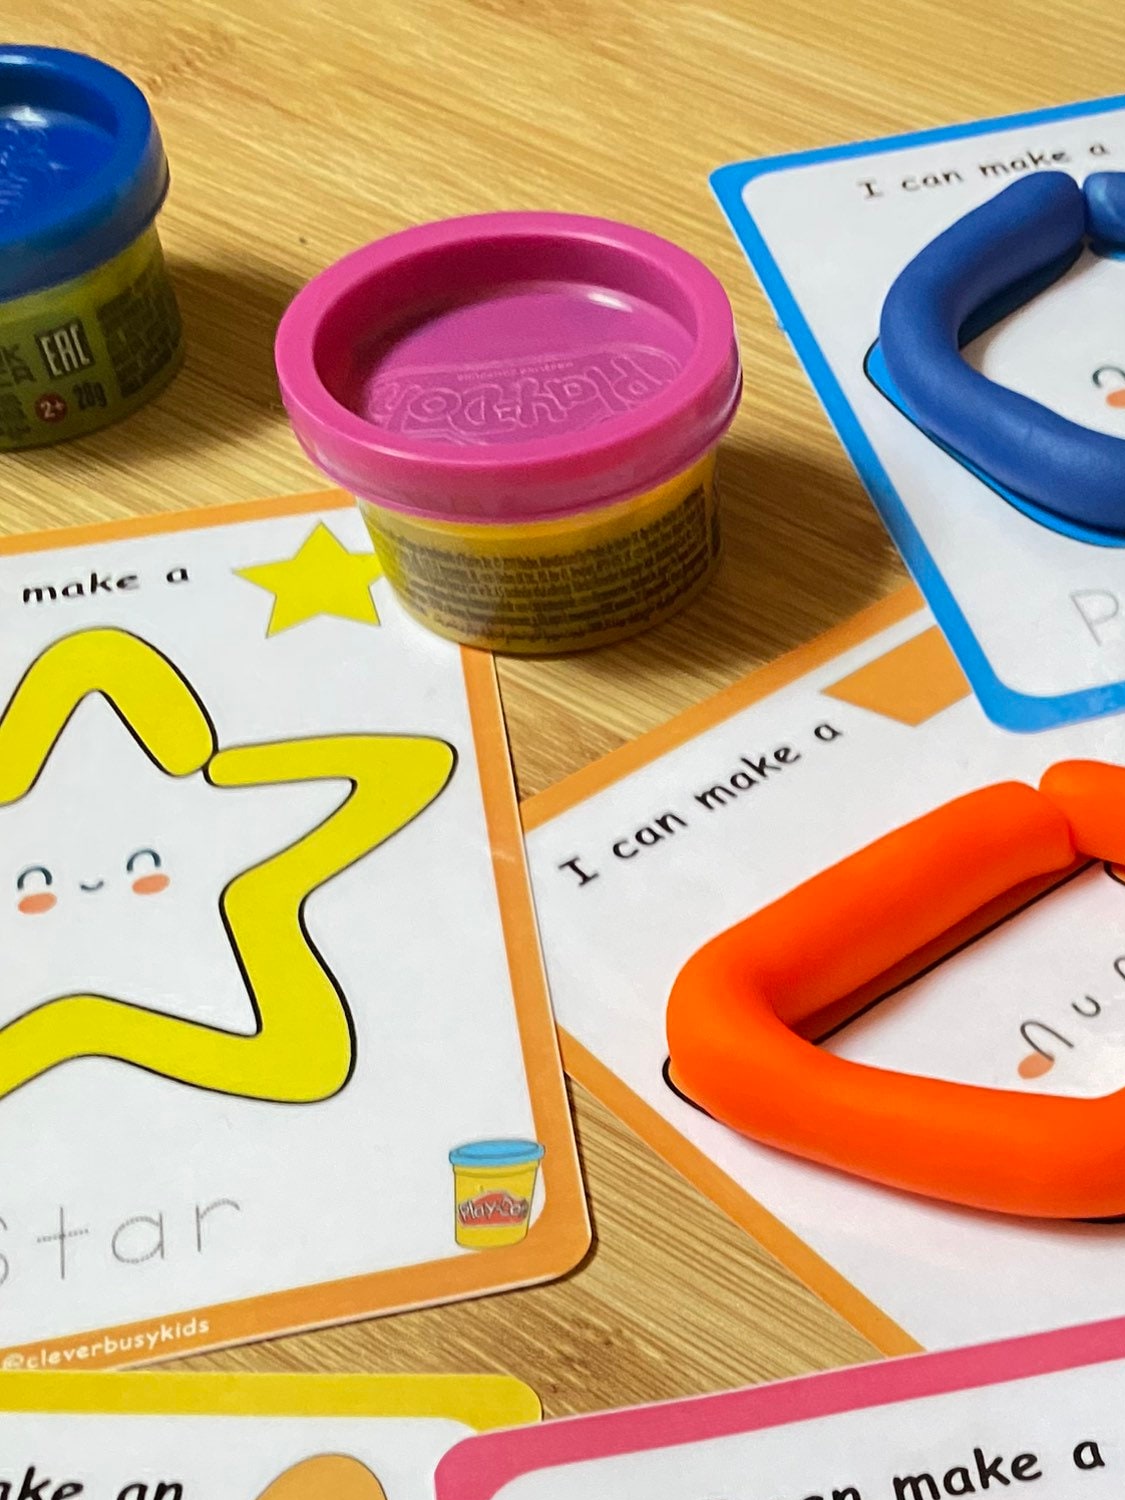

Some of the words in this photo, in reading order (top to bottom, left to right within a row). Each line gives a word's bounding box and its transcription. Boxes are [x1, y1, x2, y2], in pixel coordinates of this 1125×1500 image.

[858, 178, 884, 200] I
[901, 167, 963, 191] can
[979, 150, 1071, 178] make
[1089, 142, 1111, 156] a
[22, 572, 140, 604] make
[165, 567, 190, 583] a
[558, 856, 600, 888] I
[612, 811, 689, 860] can
[693, 746, 802, 811] make
[814, 723, 844, 742] a
[0, 1198, 241, 1285] tar
[2, 1318, 210, 1370] @cleverbusykids
[1072, 1440, 1106, 1471] a
